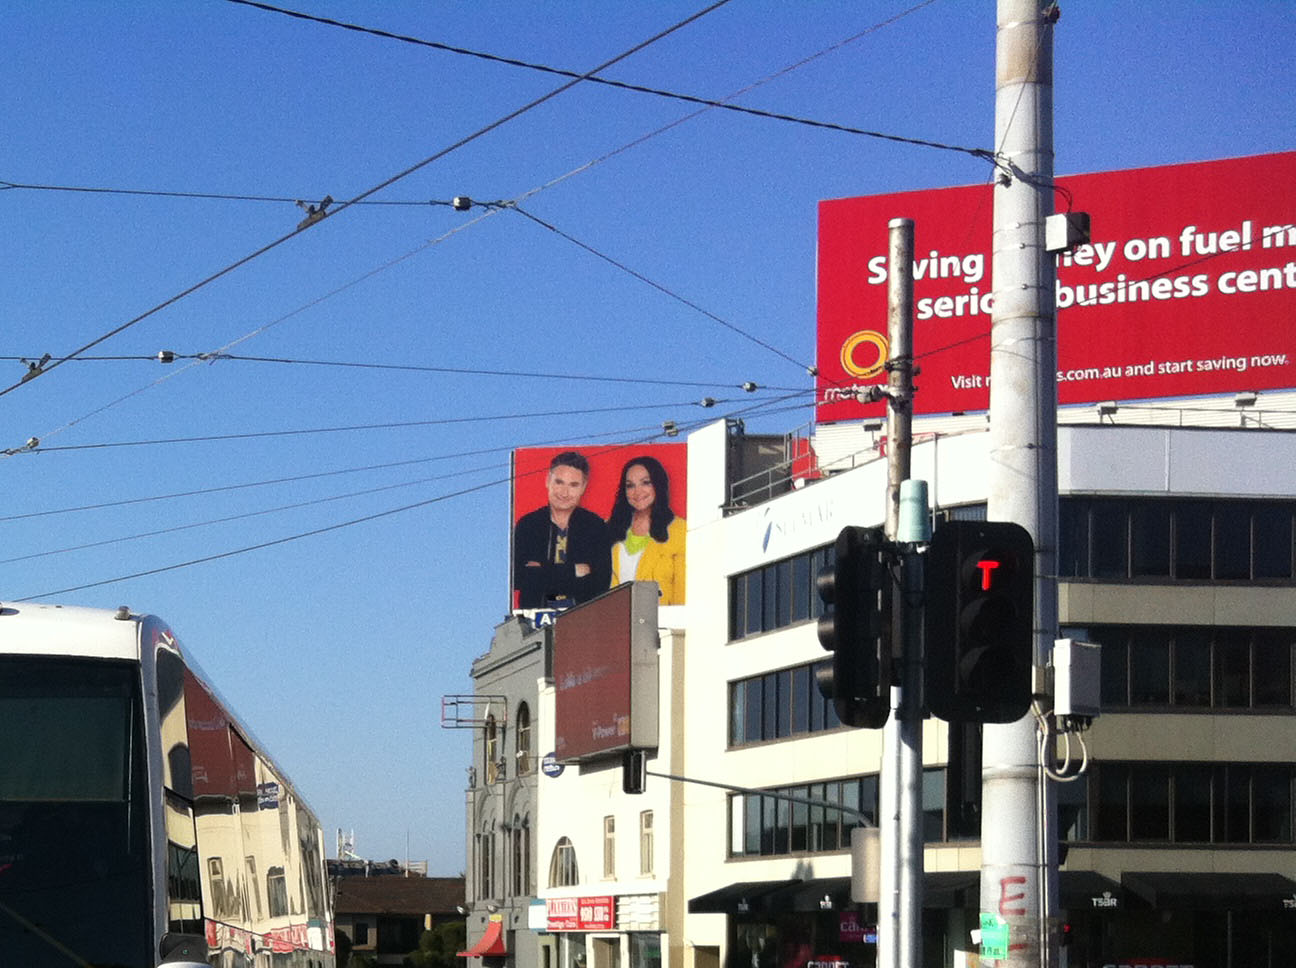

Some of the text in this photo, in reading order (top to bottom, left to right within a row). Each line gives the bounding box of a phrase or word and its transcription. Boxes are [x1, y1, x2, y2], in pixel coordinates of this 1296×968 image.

[867, 250, 984, 284] Sving
[1124, 236, 1170, 261] on
[1179, 221, 1252, 257] fuel
[1055, 273, 1208, 309] business
[1217, 262, 1296, 294] cent
[951, 375, 982, 389] Visit
[1125, 361, 1155, 377] and
[1158, 360, 1193, 375] start
[1196, 356, 1247, 372] saving
